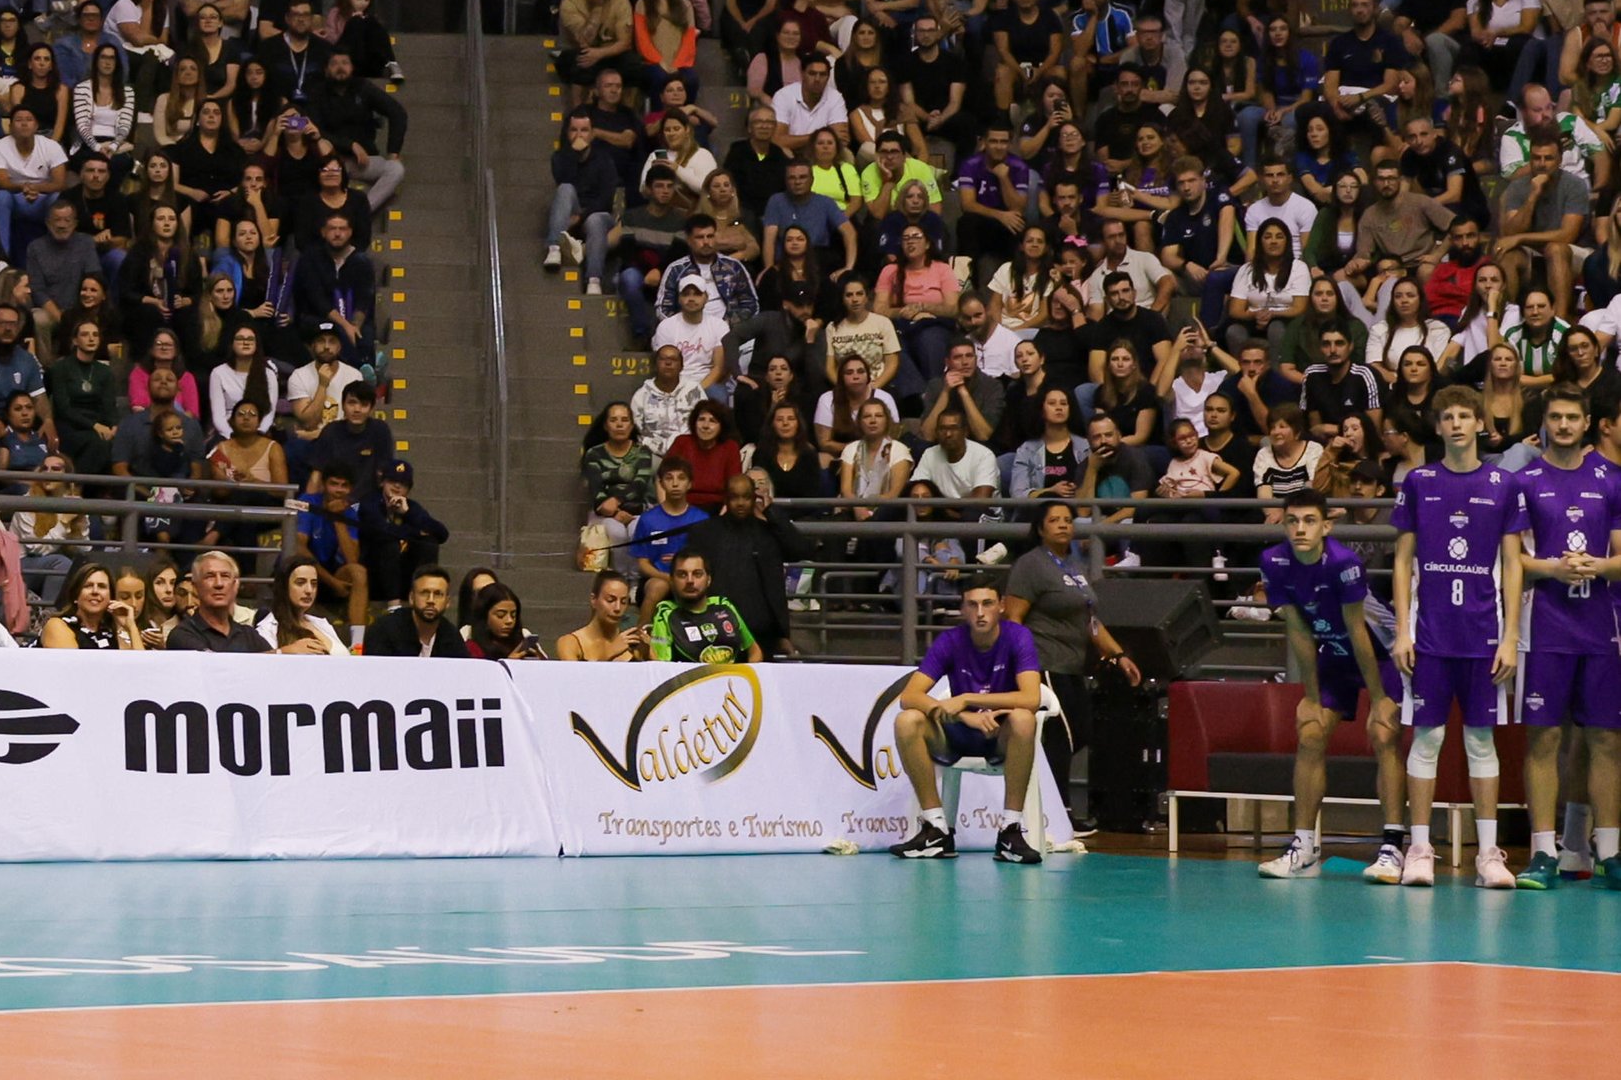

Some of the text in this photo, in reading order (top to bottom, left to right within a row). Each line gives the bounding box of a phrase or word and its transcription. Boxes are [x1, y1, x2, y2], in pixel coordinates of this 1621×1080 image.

[1424, 561, 1489, 575] CÍRCULOSAÚDE
[1451, 578, 1464, 606] 8
[124, 698, 505, 777] mormaii
[570, 664, 763, 792] Valdetur
[598, 810, 722, 845] Transportes
[729, 821, 740, 838] e
[959, 815, 970, 829] e
